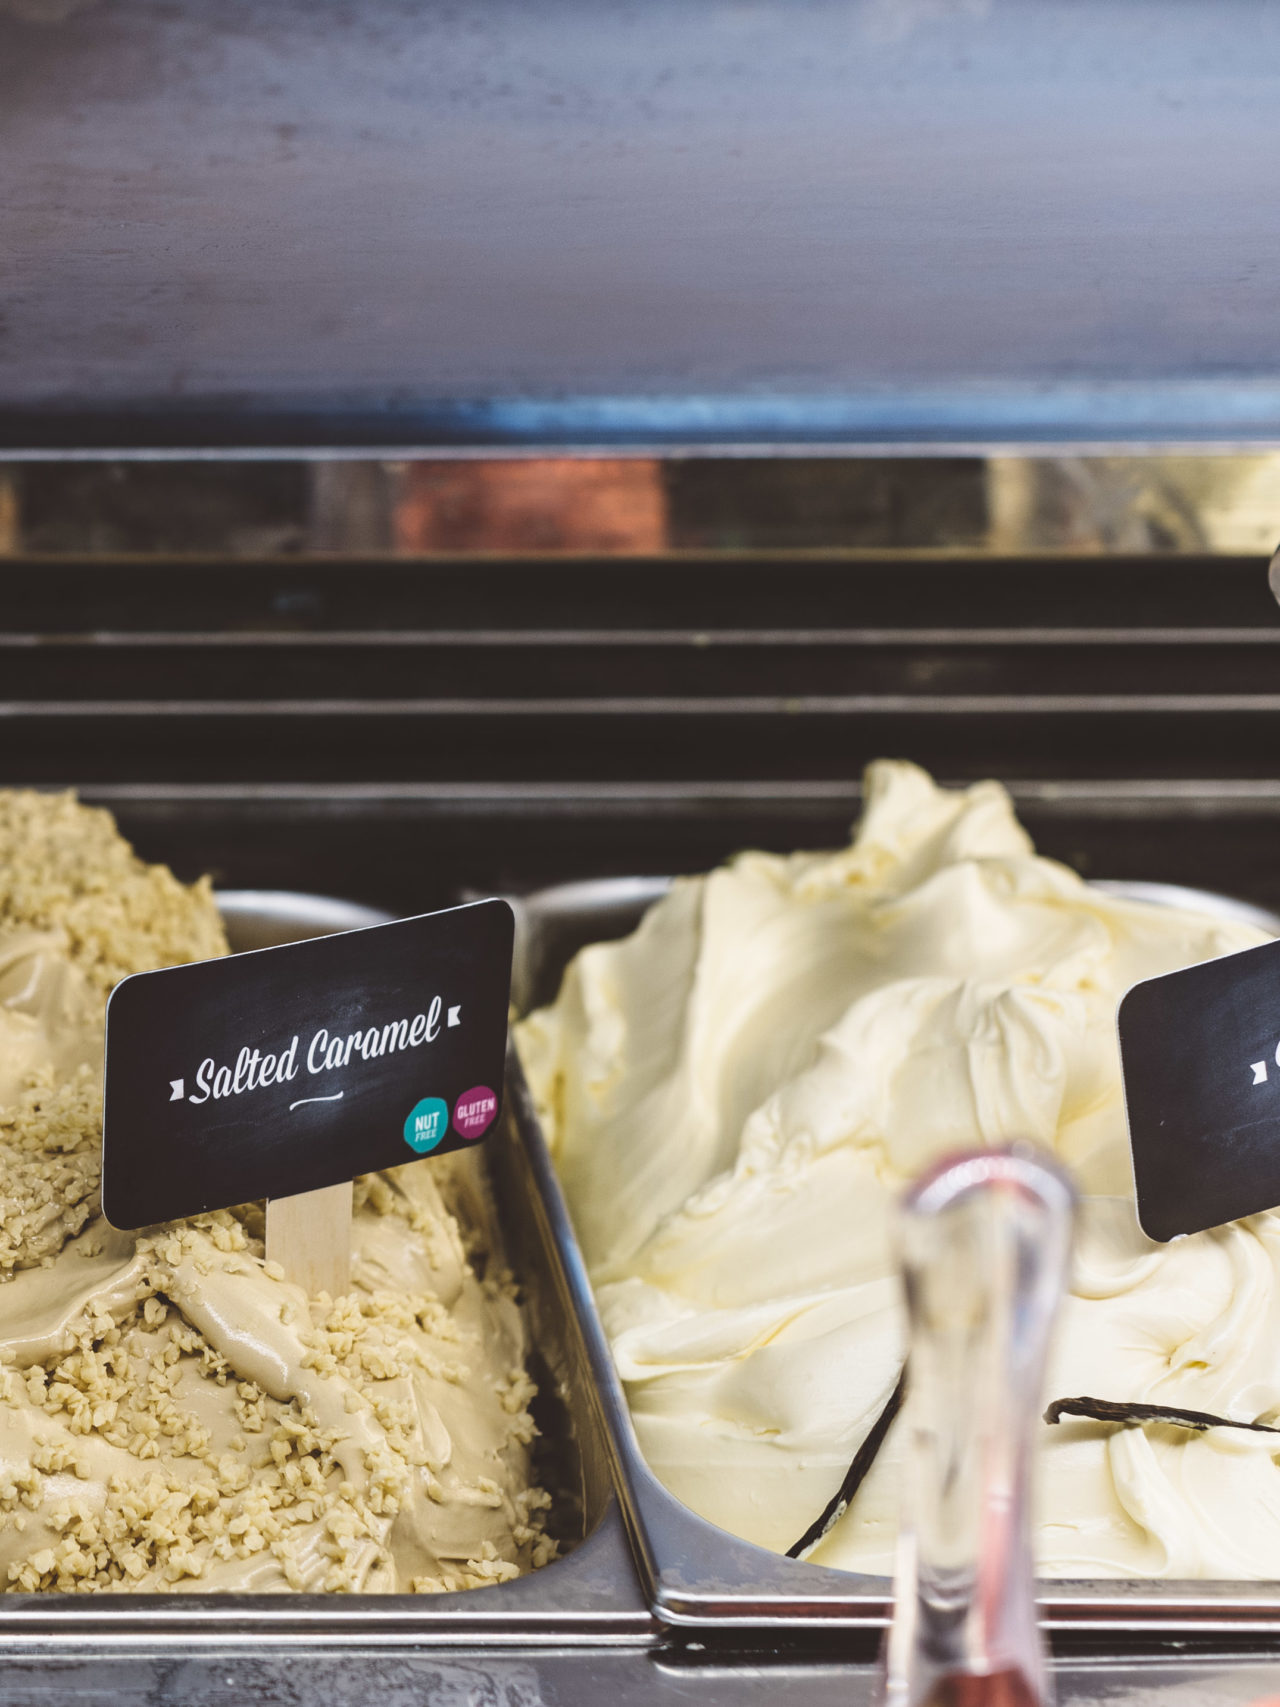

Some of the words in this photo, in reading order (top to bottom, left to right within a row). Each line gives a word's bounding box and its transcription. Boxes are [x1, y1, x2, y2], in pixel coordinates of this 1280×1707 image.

[189, 1035, 299, 1104] Salted
[306, 995, 442, 1074] Caramel
[457, 1097, 495, 1120] GLUTEN
[415, 1111, 440, 1133] NUT
[464, 1114, 486, 1128] FREE
[414, 1128, 437, 1142] FREE
